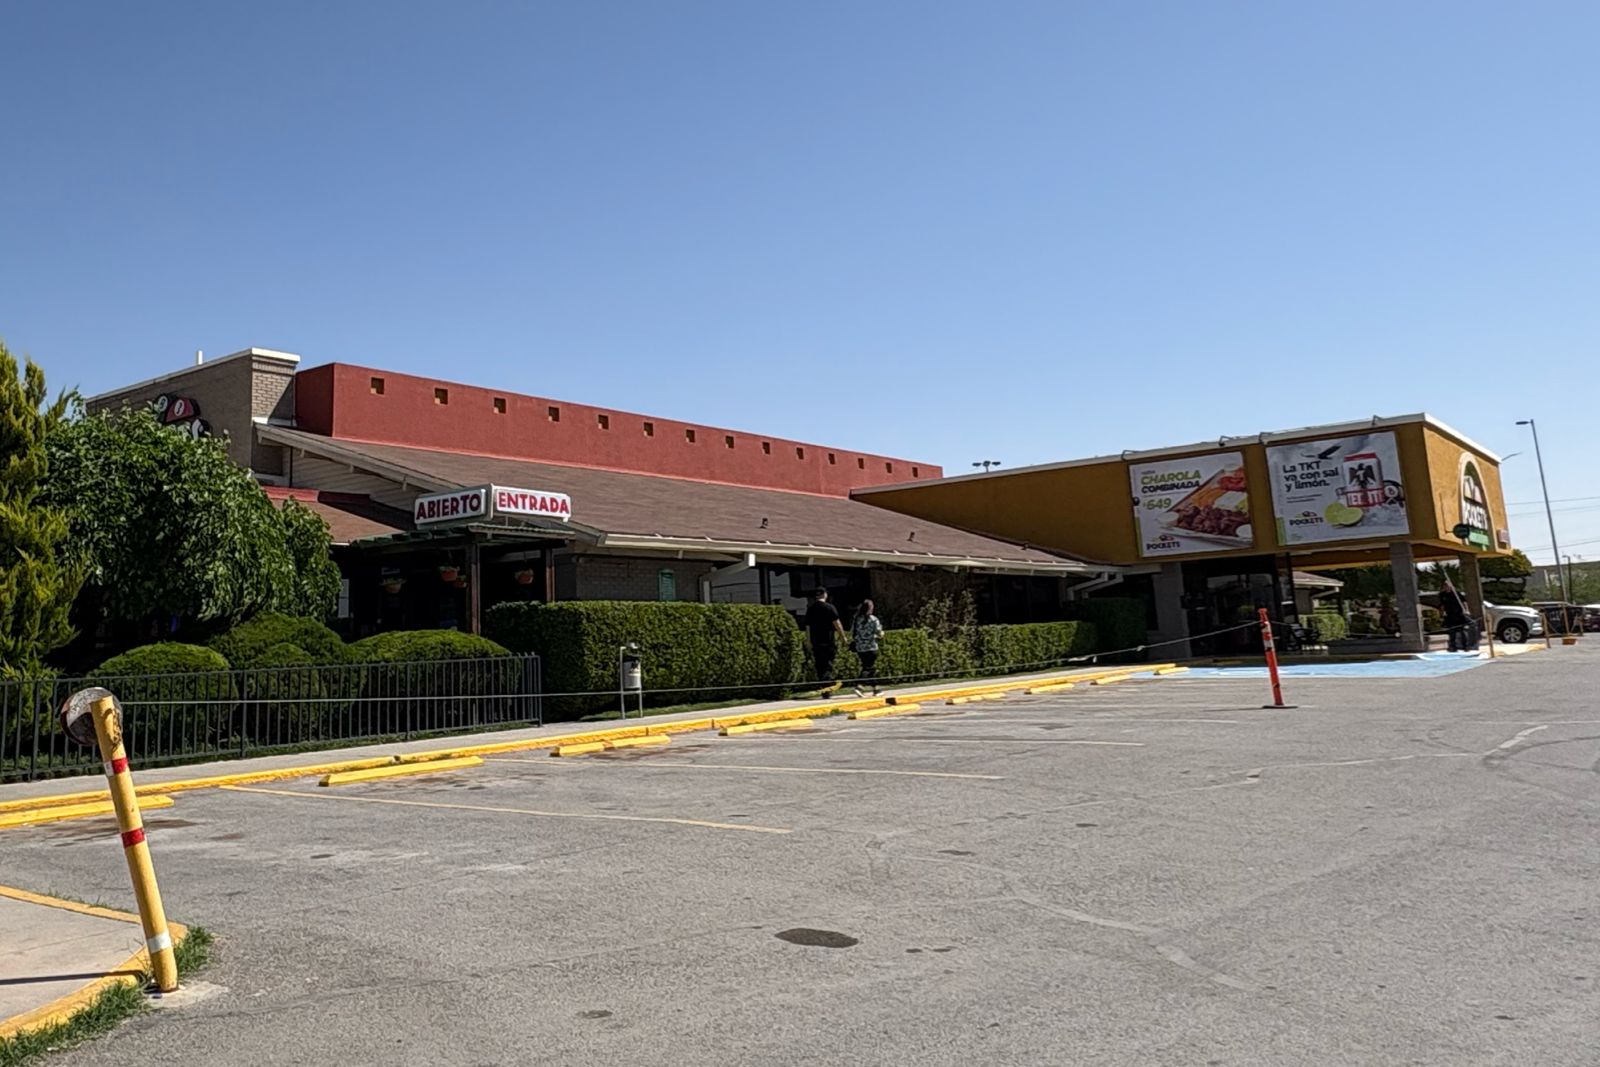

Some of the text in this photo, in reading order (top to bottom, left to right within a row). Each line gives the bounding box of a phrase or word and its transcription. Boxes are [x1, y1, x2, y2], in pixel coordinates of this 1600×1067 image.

[1282, 461, 1322, 473] La TKT
[1141, 470, 1201, 485] CHAROLA
[1284, 467, 1339, 482] va con sal
[1141, 480, 1200, 493] COMBINADA
[1285, 483, 1292, 492] y
[416, 493, 481, 520] ABIERTO
[498, 492, 569, 515] ENTRADA
[1289, 517, 1324, 526] POCKETS
[1146, 541, 1181, 550] POCKETS
